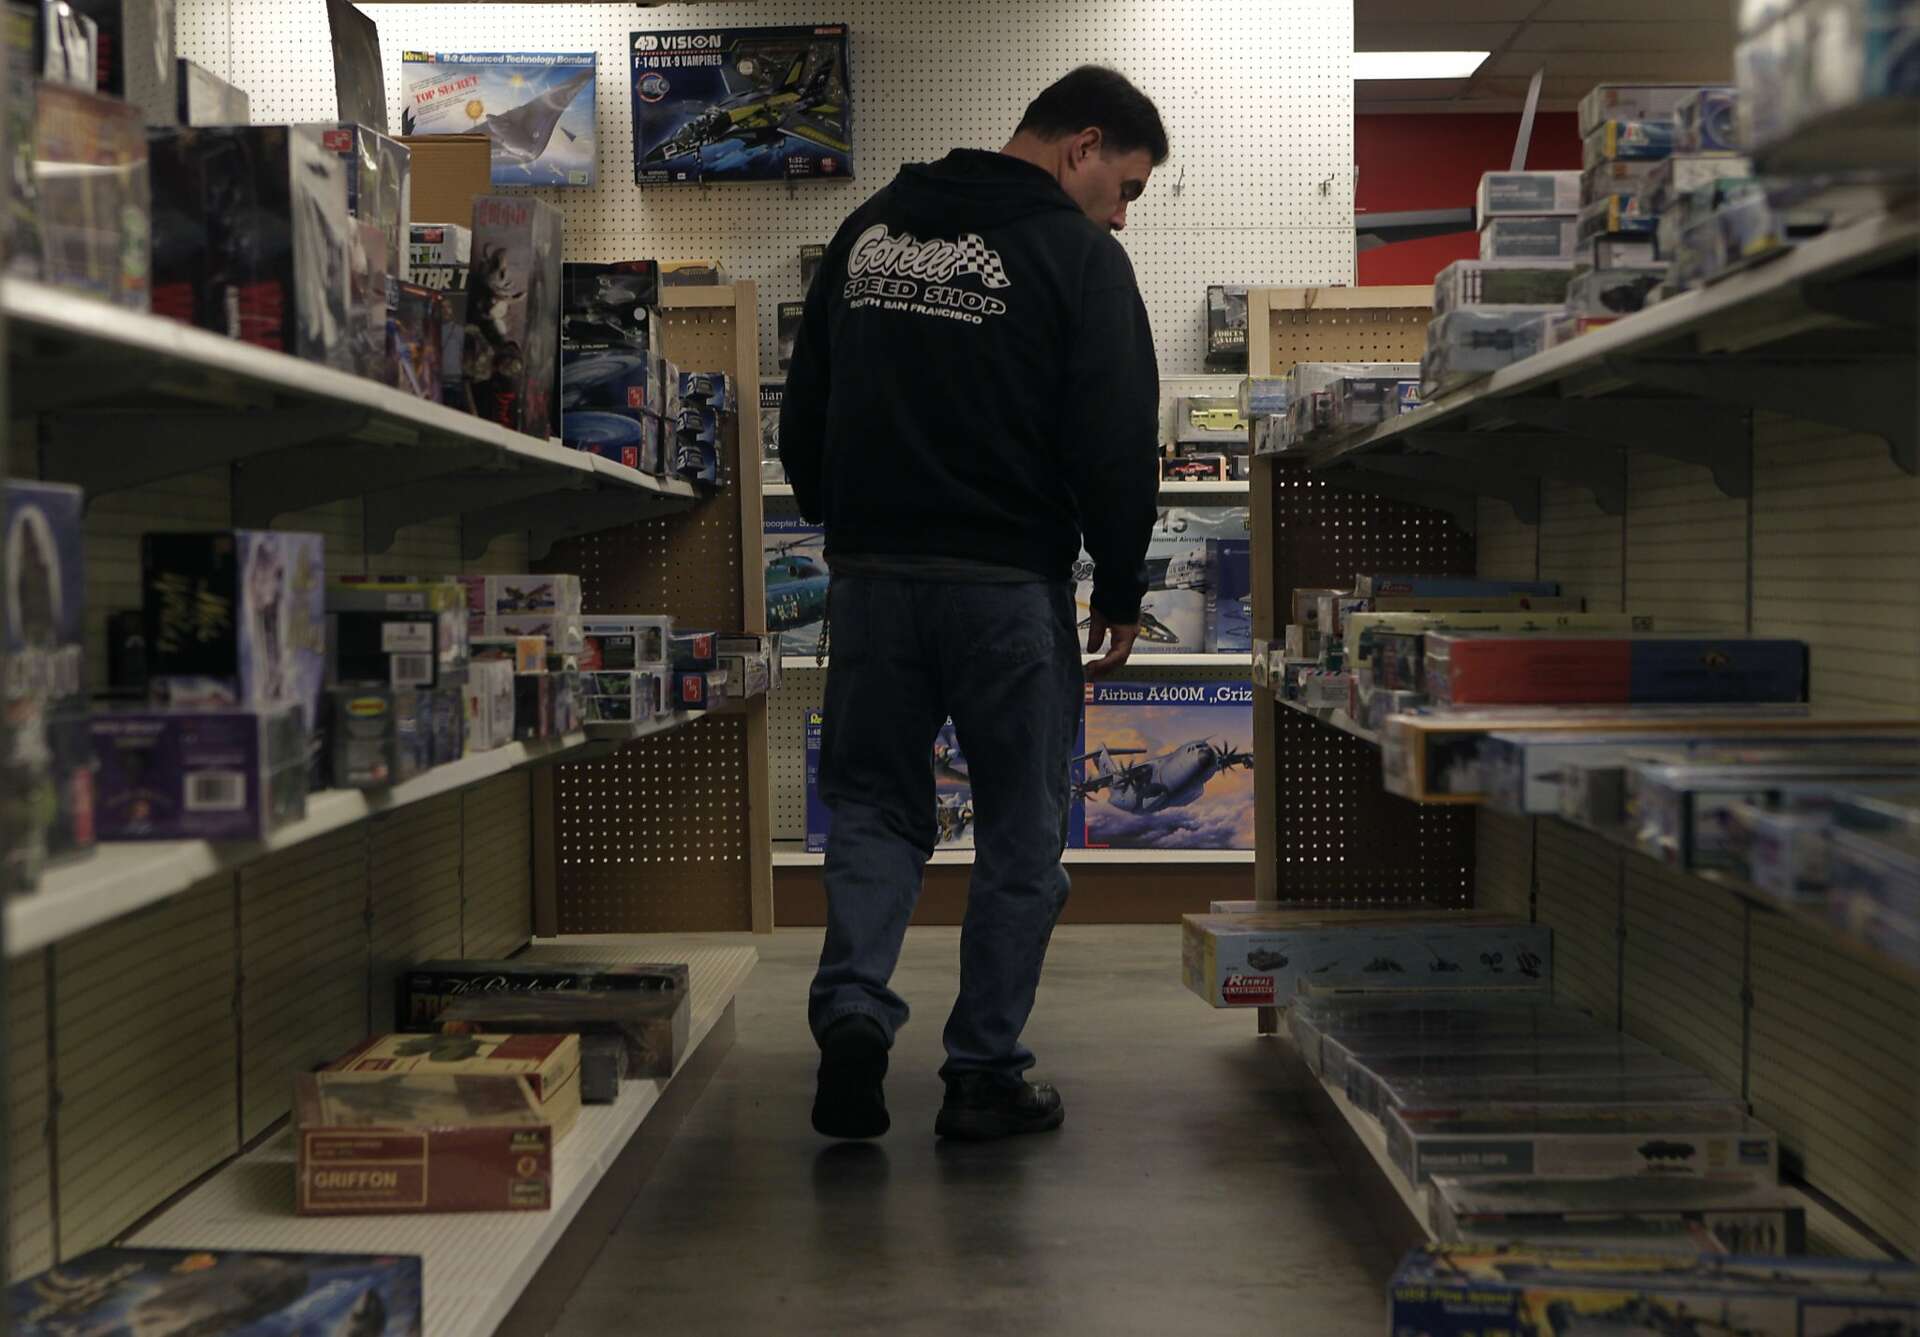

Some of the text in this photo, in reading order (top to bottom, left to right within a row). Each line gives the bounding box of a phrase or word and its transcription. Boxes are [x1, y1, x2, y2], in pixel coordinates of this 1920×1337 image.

[634, 36, 659, 50] 4D
[459, 54, 504, 64] Advanced
[505, 54, 556, 66] Technology
[557, 55, 592, 65] Bomber
[681, 54, 723, 67] VAMPIRES
[415, 74, 479, 104] TOP SECRET
[843, 277, 1007, 315] SPEED SHOP
[883, 301, 908, 312] SAN
[909, 303, 984, 325] FRANCISCO
[1098, 687, 1253, 704] Airbus A400M „Griz
[314, 1170, 398, 1189] GRIFFON
